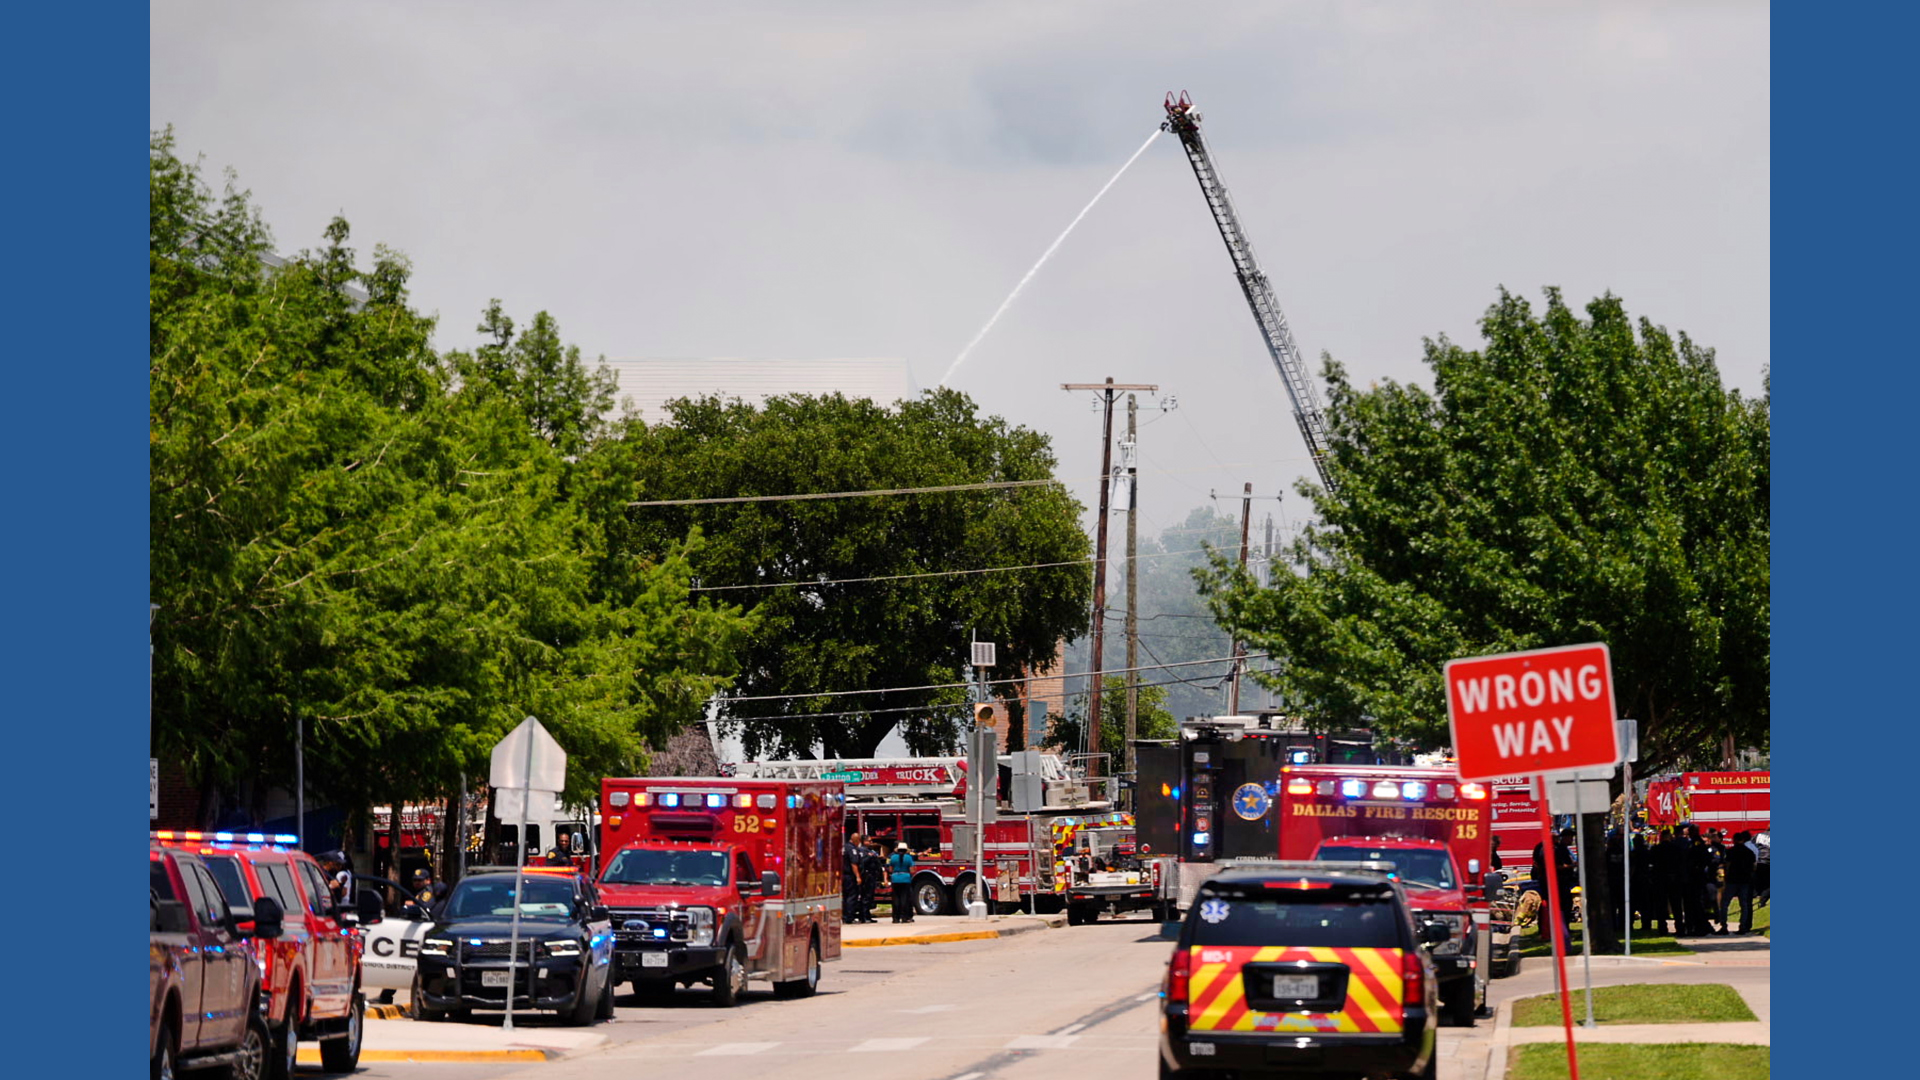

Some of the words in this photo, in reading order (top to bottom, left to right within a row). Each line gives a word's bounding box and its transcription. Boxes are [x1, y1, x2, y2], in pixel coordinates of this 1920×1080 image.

[1457, 664, 1601, 714] WRONG
[1492, 715, 1574, 759] WAY
[896, 768, 940, 782] TRUCK
[1710, 776, 1748, 785] DALLAS
[1292, 803, 1357, 818] DALLAS
[1364, 806, 1406, 820] FIRE
[1412, 807, 1479, 821] RESCUE
[1657, 791, 1673, 815] 14
[733, 815, 760, 833] 52
[1456, 824, 1478, 840] 15
